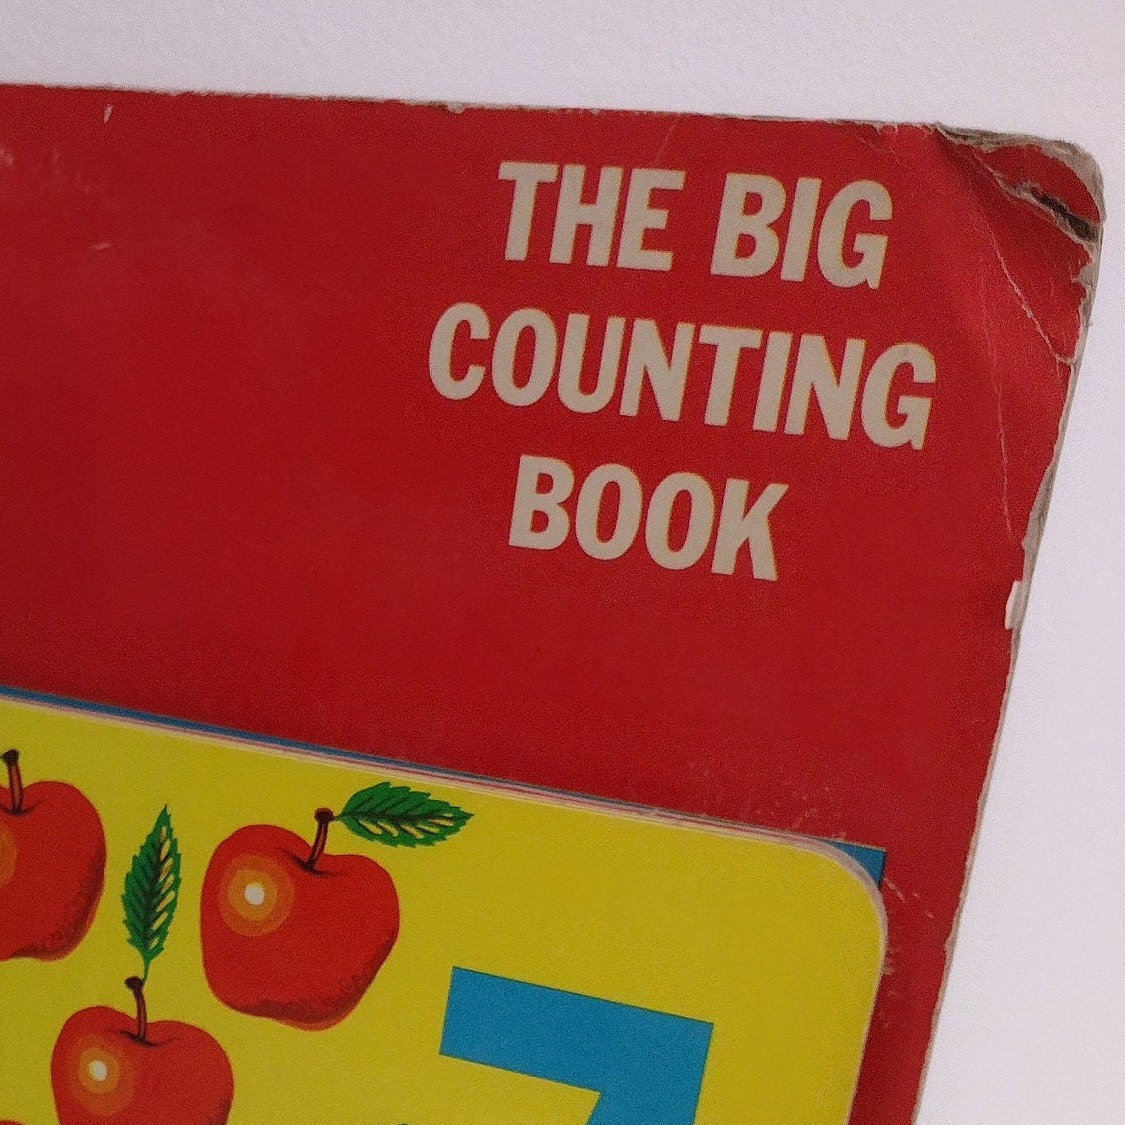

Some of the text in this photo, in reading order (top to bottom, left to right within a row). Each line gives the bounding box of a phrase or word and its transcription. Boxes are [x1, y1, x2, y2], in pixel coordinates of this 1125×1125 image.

[497, 160, 894, 290] THE BIG
[427, 302, 937, 450] COUNTING
[508, 454, 789, 582] BOOK
